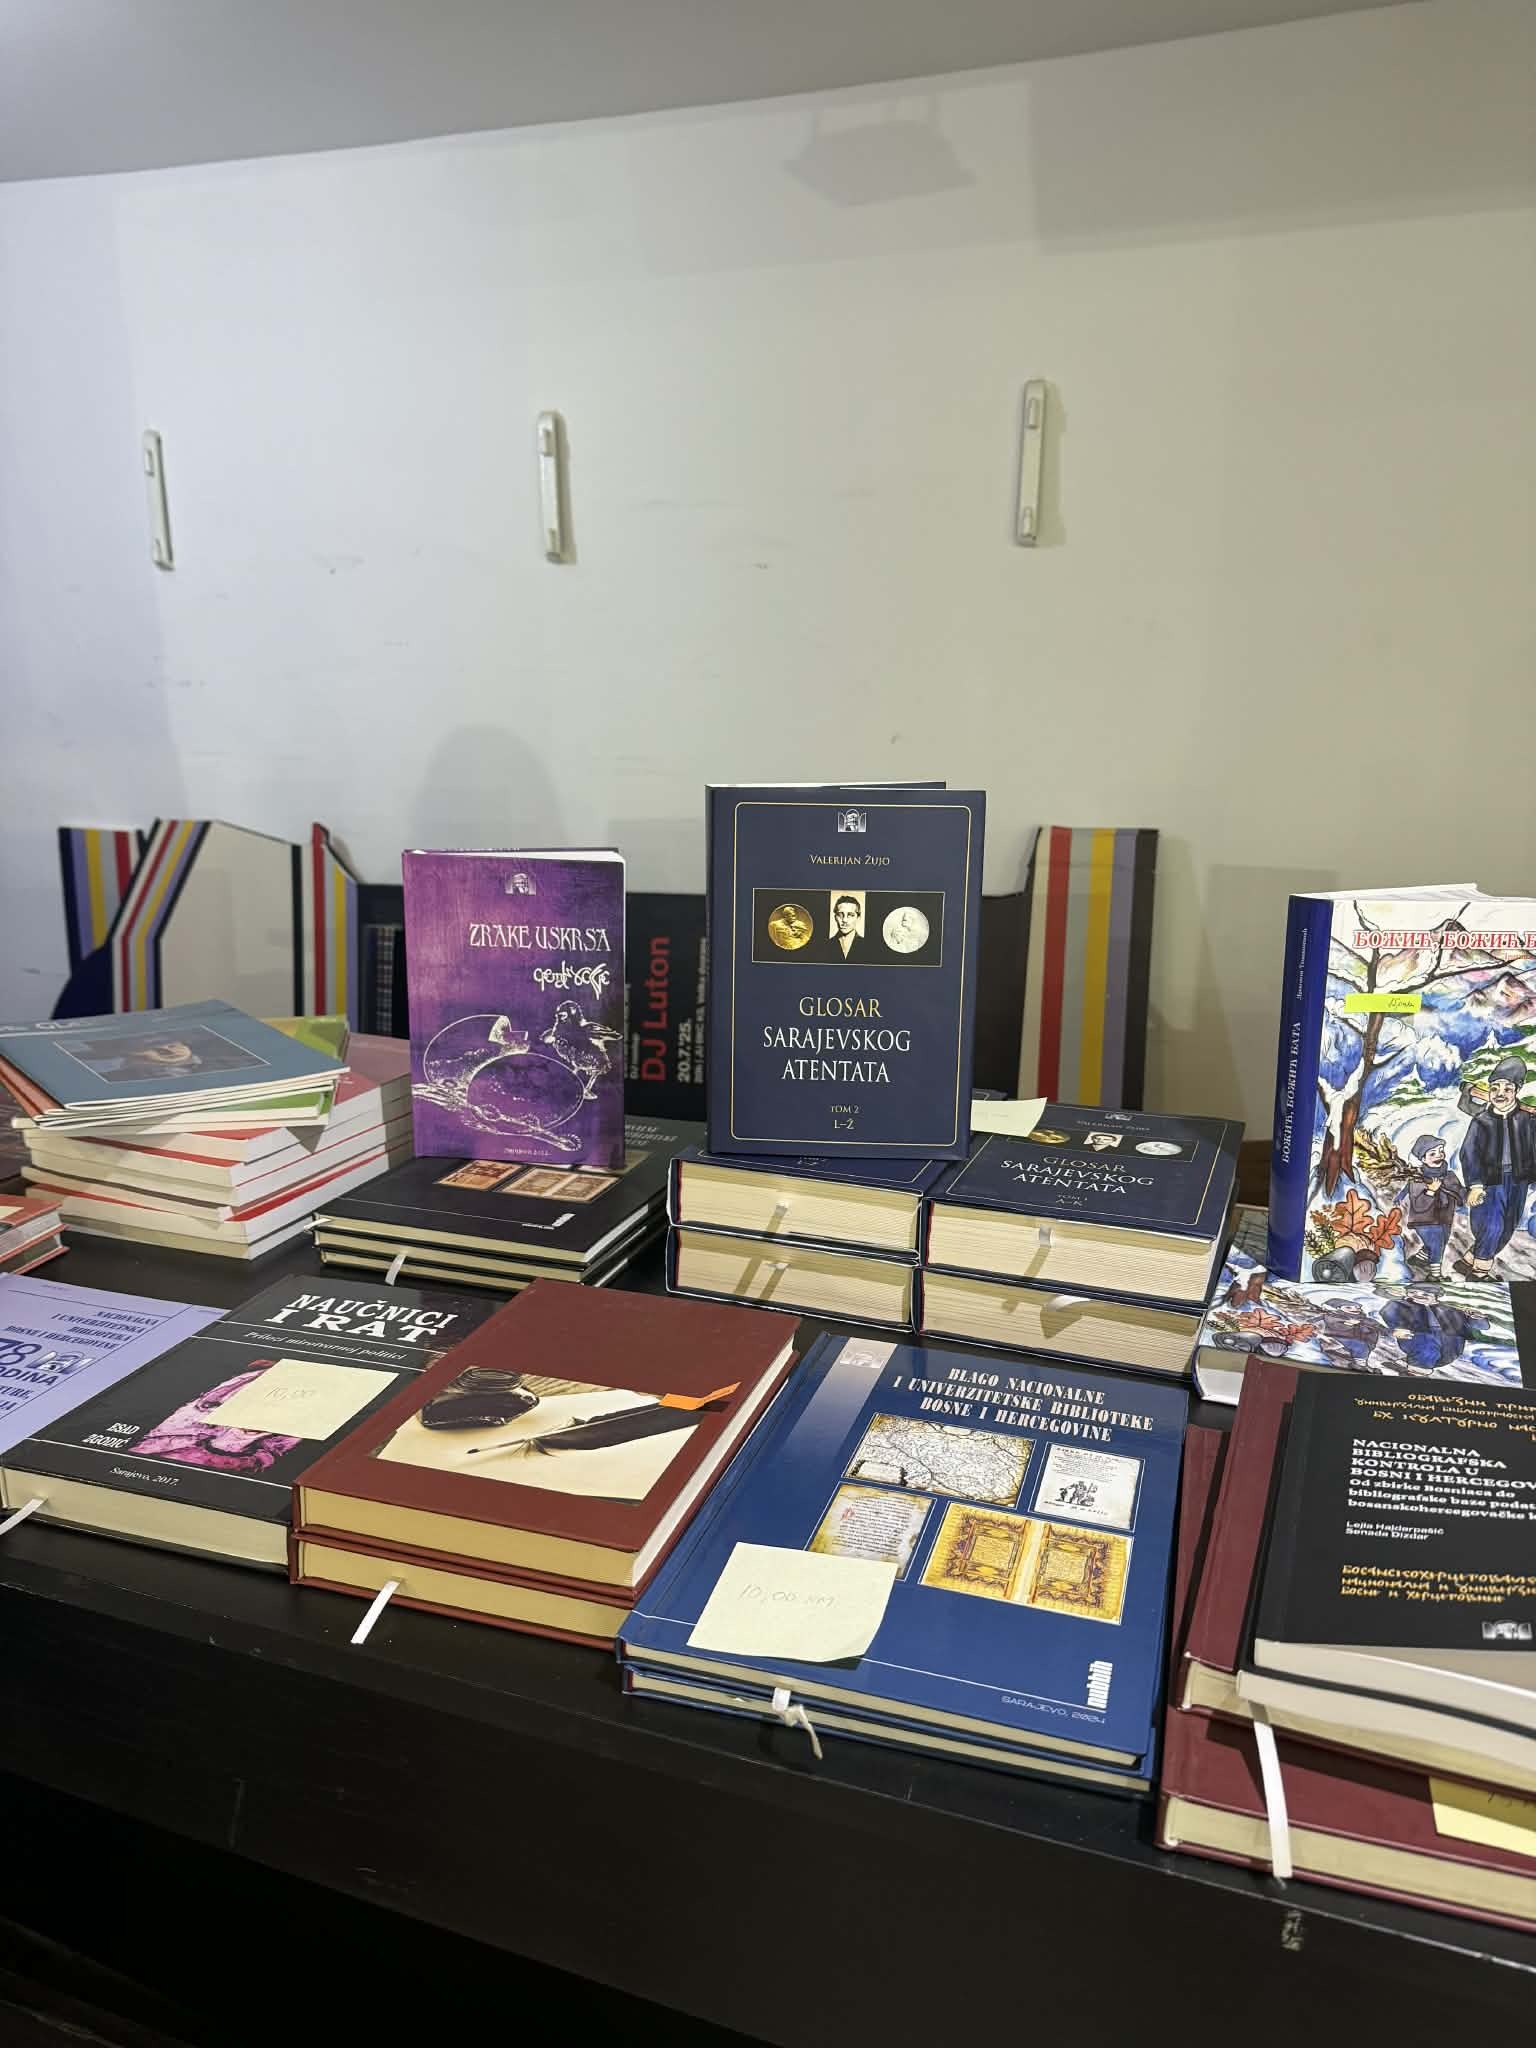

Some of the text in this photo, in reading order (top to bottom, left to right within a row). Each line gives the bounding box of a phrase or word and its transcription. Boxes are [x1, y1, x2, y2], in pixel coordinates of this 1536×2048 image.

[469, 923, 611, 951] ZRAKE USKRSA
[1354, 930, 1438, 950] БОЖИЋ,
[1443, 930, 1520, 949] БОЖИЋ
[640, 936, 670, 1081] DJ Luton
[799, 996, 883, 1018] GLOSAR
[763, 1026, 911, 1055] SARAJEVSKOG
[781, 1058, 891, 1083] ATENTATA
[1001, 1159, 1155, 1186] SARAJEVSKOG
[1043, 1155, 1126, 1173] GLOSAR
[1013, 1172, 1127, 1194] ATENTATA
[286, 1294, 459, 1329] NAUČNICI
[264, 1308, 437, 1343] I RAT
[948, 1367, 1105, 1405] BLAGO NACIONALNE
[892, 1375, 1154, 1431] I UNIVERZITETSKE BIBLIOTEKE
[105, 1422, 141, 1435] ESAD
[920, 1396, 1113, 1442] BOSNE I HERCEGOVINE
[1351, 1448, 1507, 1469] BIBLIOGRAFSKA
[1352, 1438, 1481, 1458] NACIONALNA
[1350, 1467, 1410, 1480] BOSNI
[1415, 1473, 1423, 1481] I
[1351, 1457, 1479, 1476] KONTROLA U
[1348, 1488, 1450, 1505] bibliografske
[1450, 1496, 1487, 1507] baze
[1349, 1478, 1516, 1499] Od zbirke Bosniaca do
[1347, 1499, 1526, 1521] bosanskohercegovačke
[1345, 1528, 1429, 1541] Senada Dizdar
